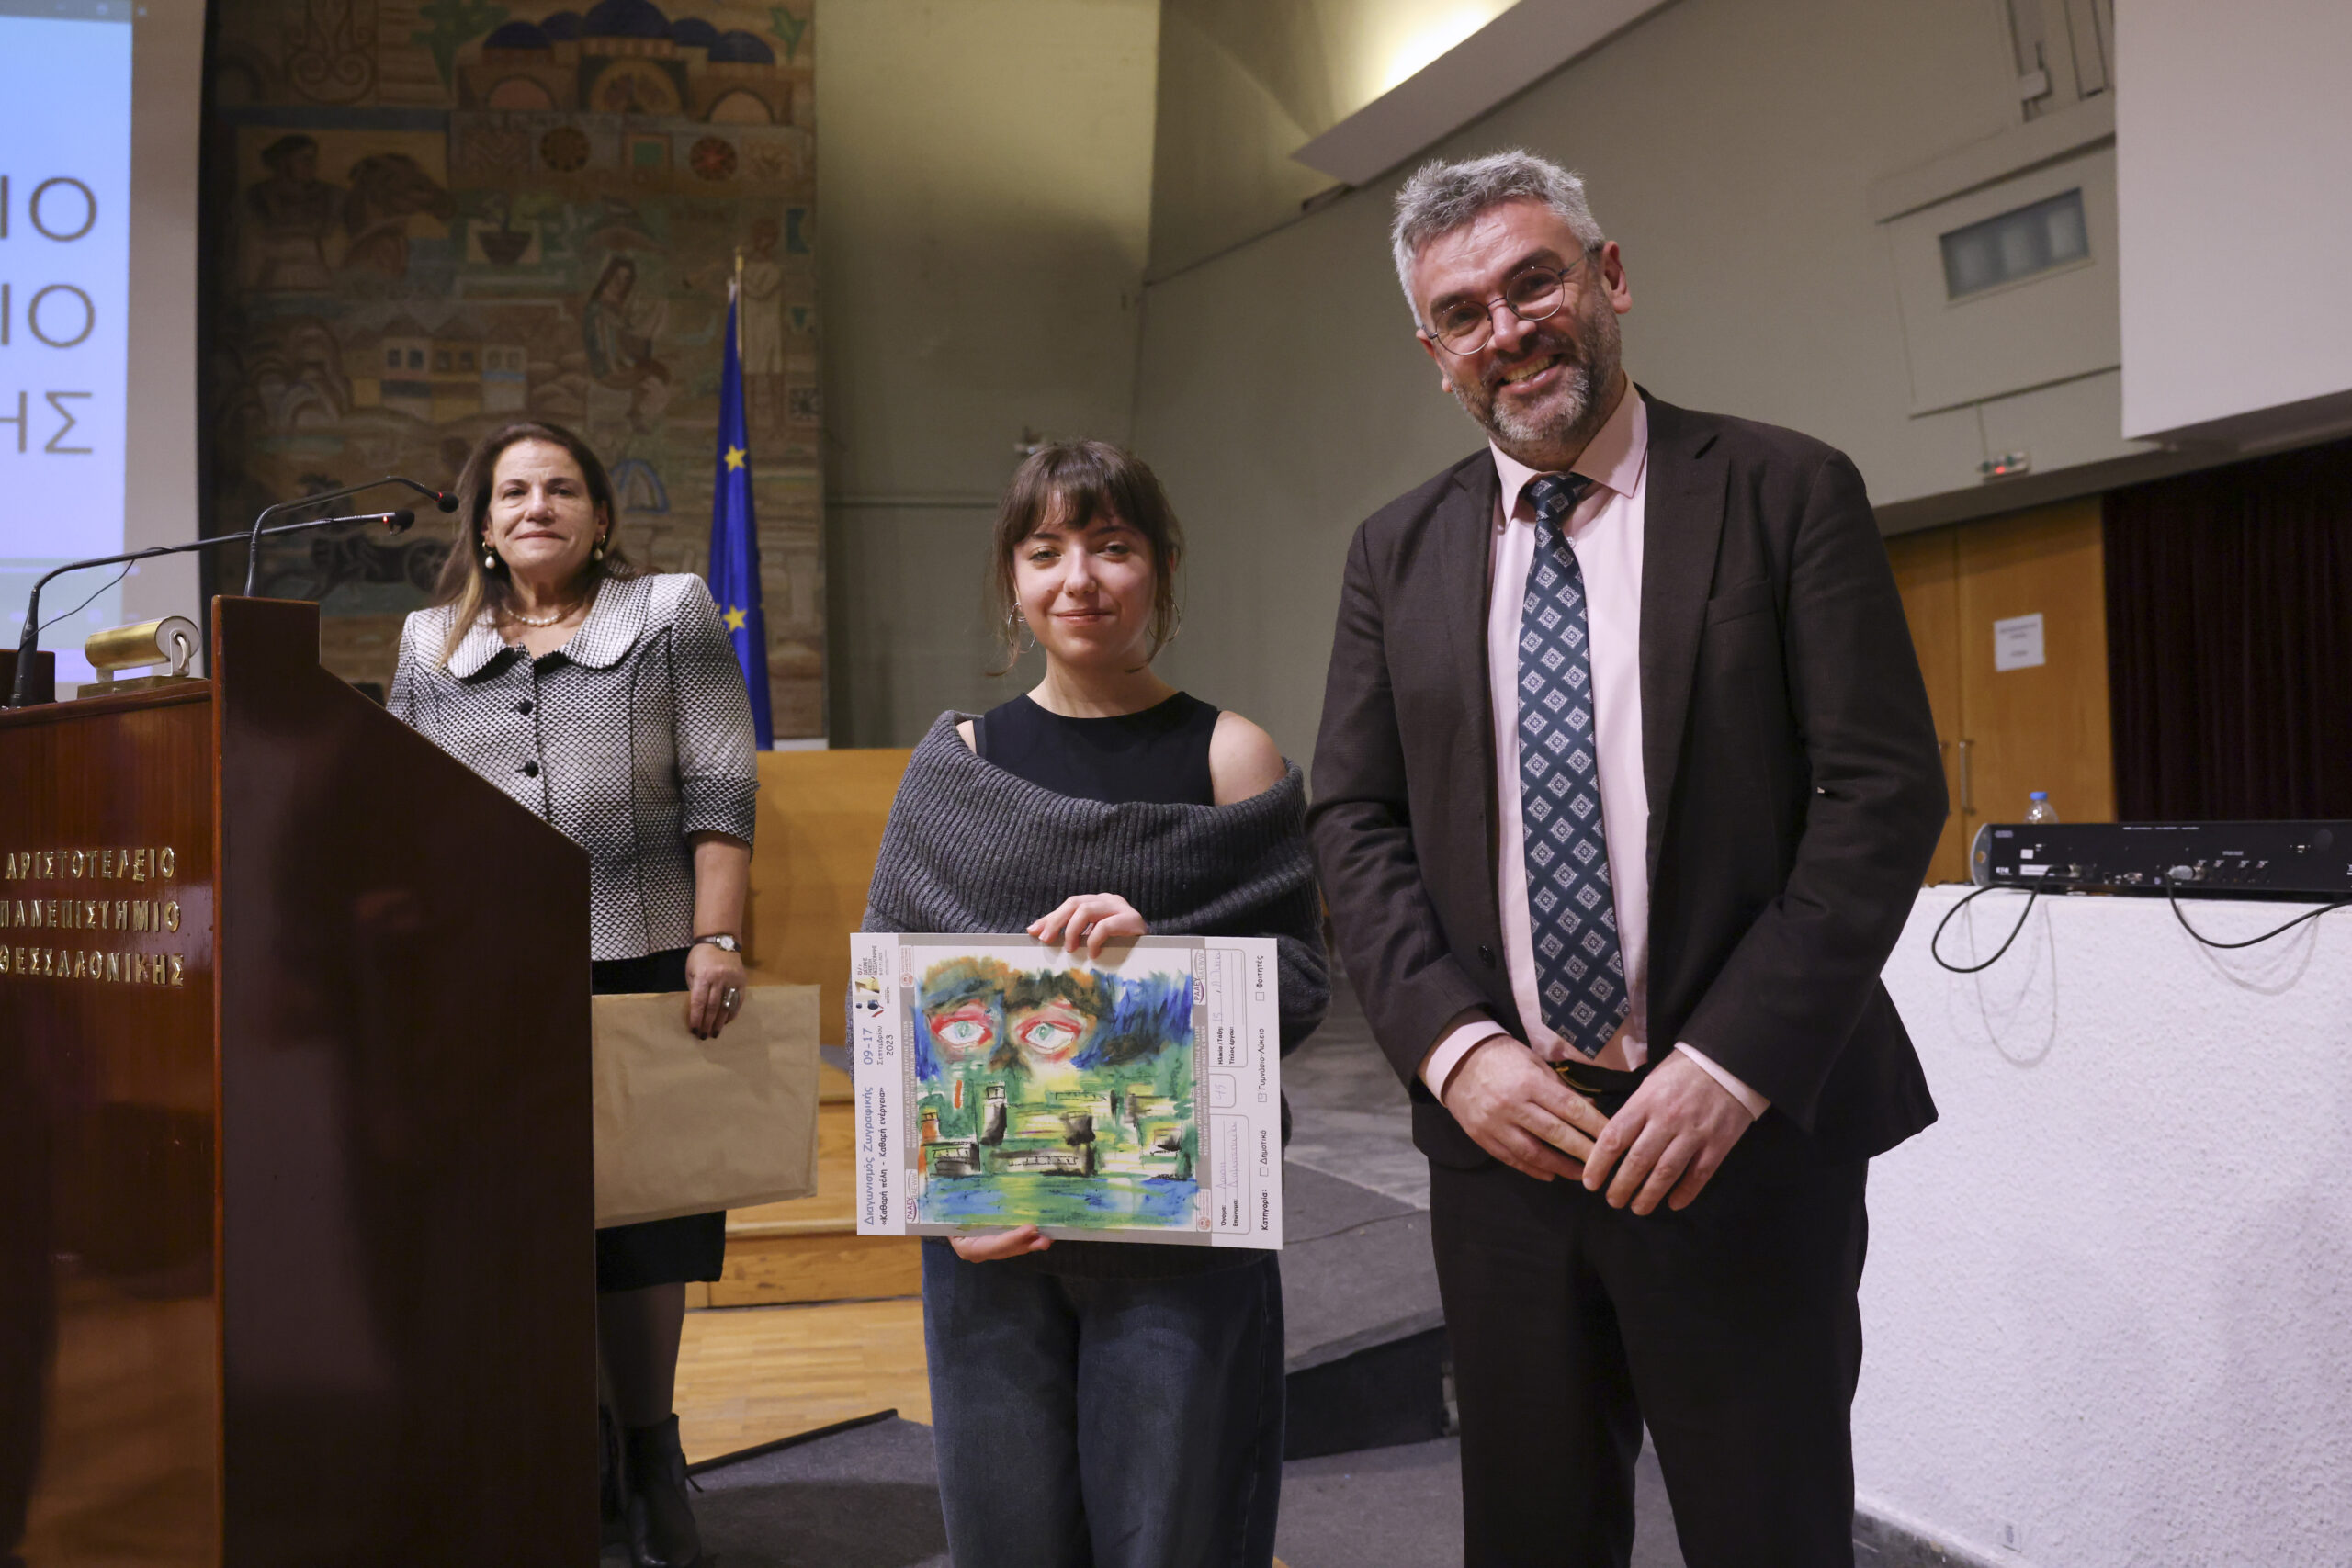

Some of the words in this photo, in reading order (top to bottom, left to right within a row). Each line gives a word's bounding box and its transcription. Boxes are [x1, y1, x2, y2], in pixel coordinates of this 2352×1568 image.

[5, 846, 176, 882] ΑΡΙΣΤΟΤΕΛΕΙΟ
[0, 899, 181, 932] ΠΑΝΕΠΙΣΤΗΜΙΟ
[0, 944, 184, 987] ΘΕΣΣΑΛΟΝΙΚΗΣ
[1255, 955, 1264, 989] Φοιτητές
[885, 1034, 895, 1056] 2023
[862, 1087, 875, 1153] Ζωγραφικής
[878, 1128, 888, 1157] Καθαρή
[1259, 1129, 1268, 1165] Δημοτικό
[863, 1156, 876, 1226] Διαγωνισμός
[879, 1169, 888, 1188] πόλη
[1260, 1190, 1269, 1231] Κατηγορία:
